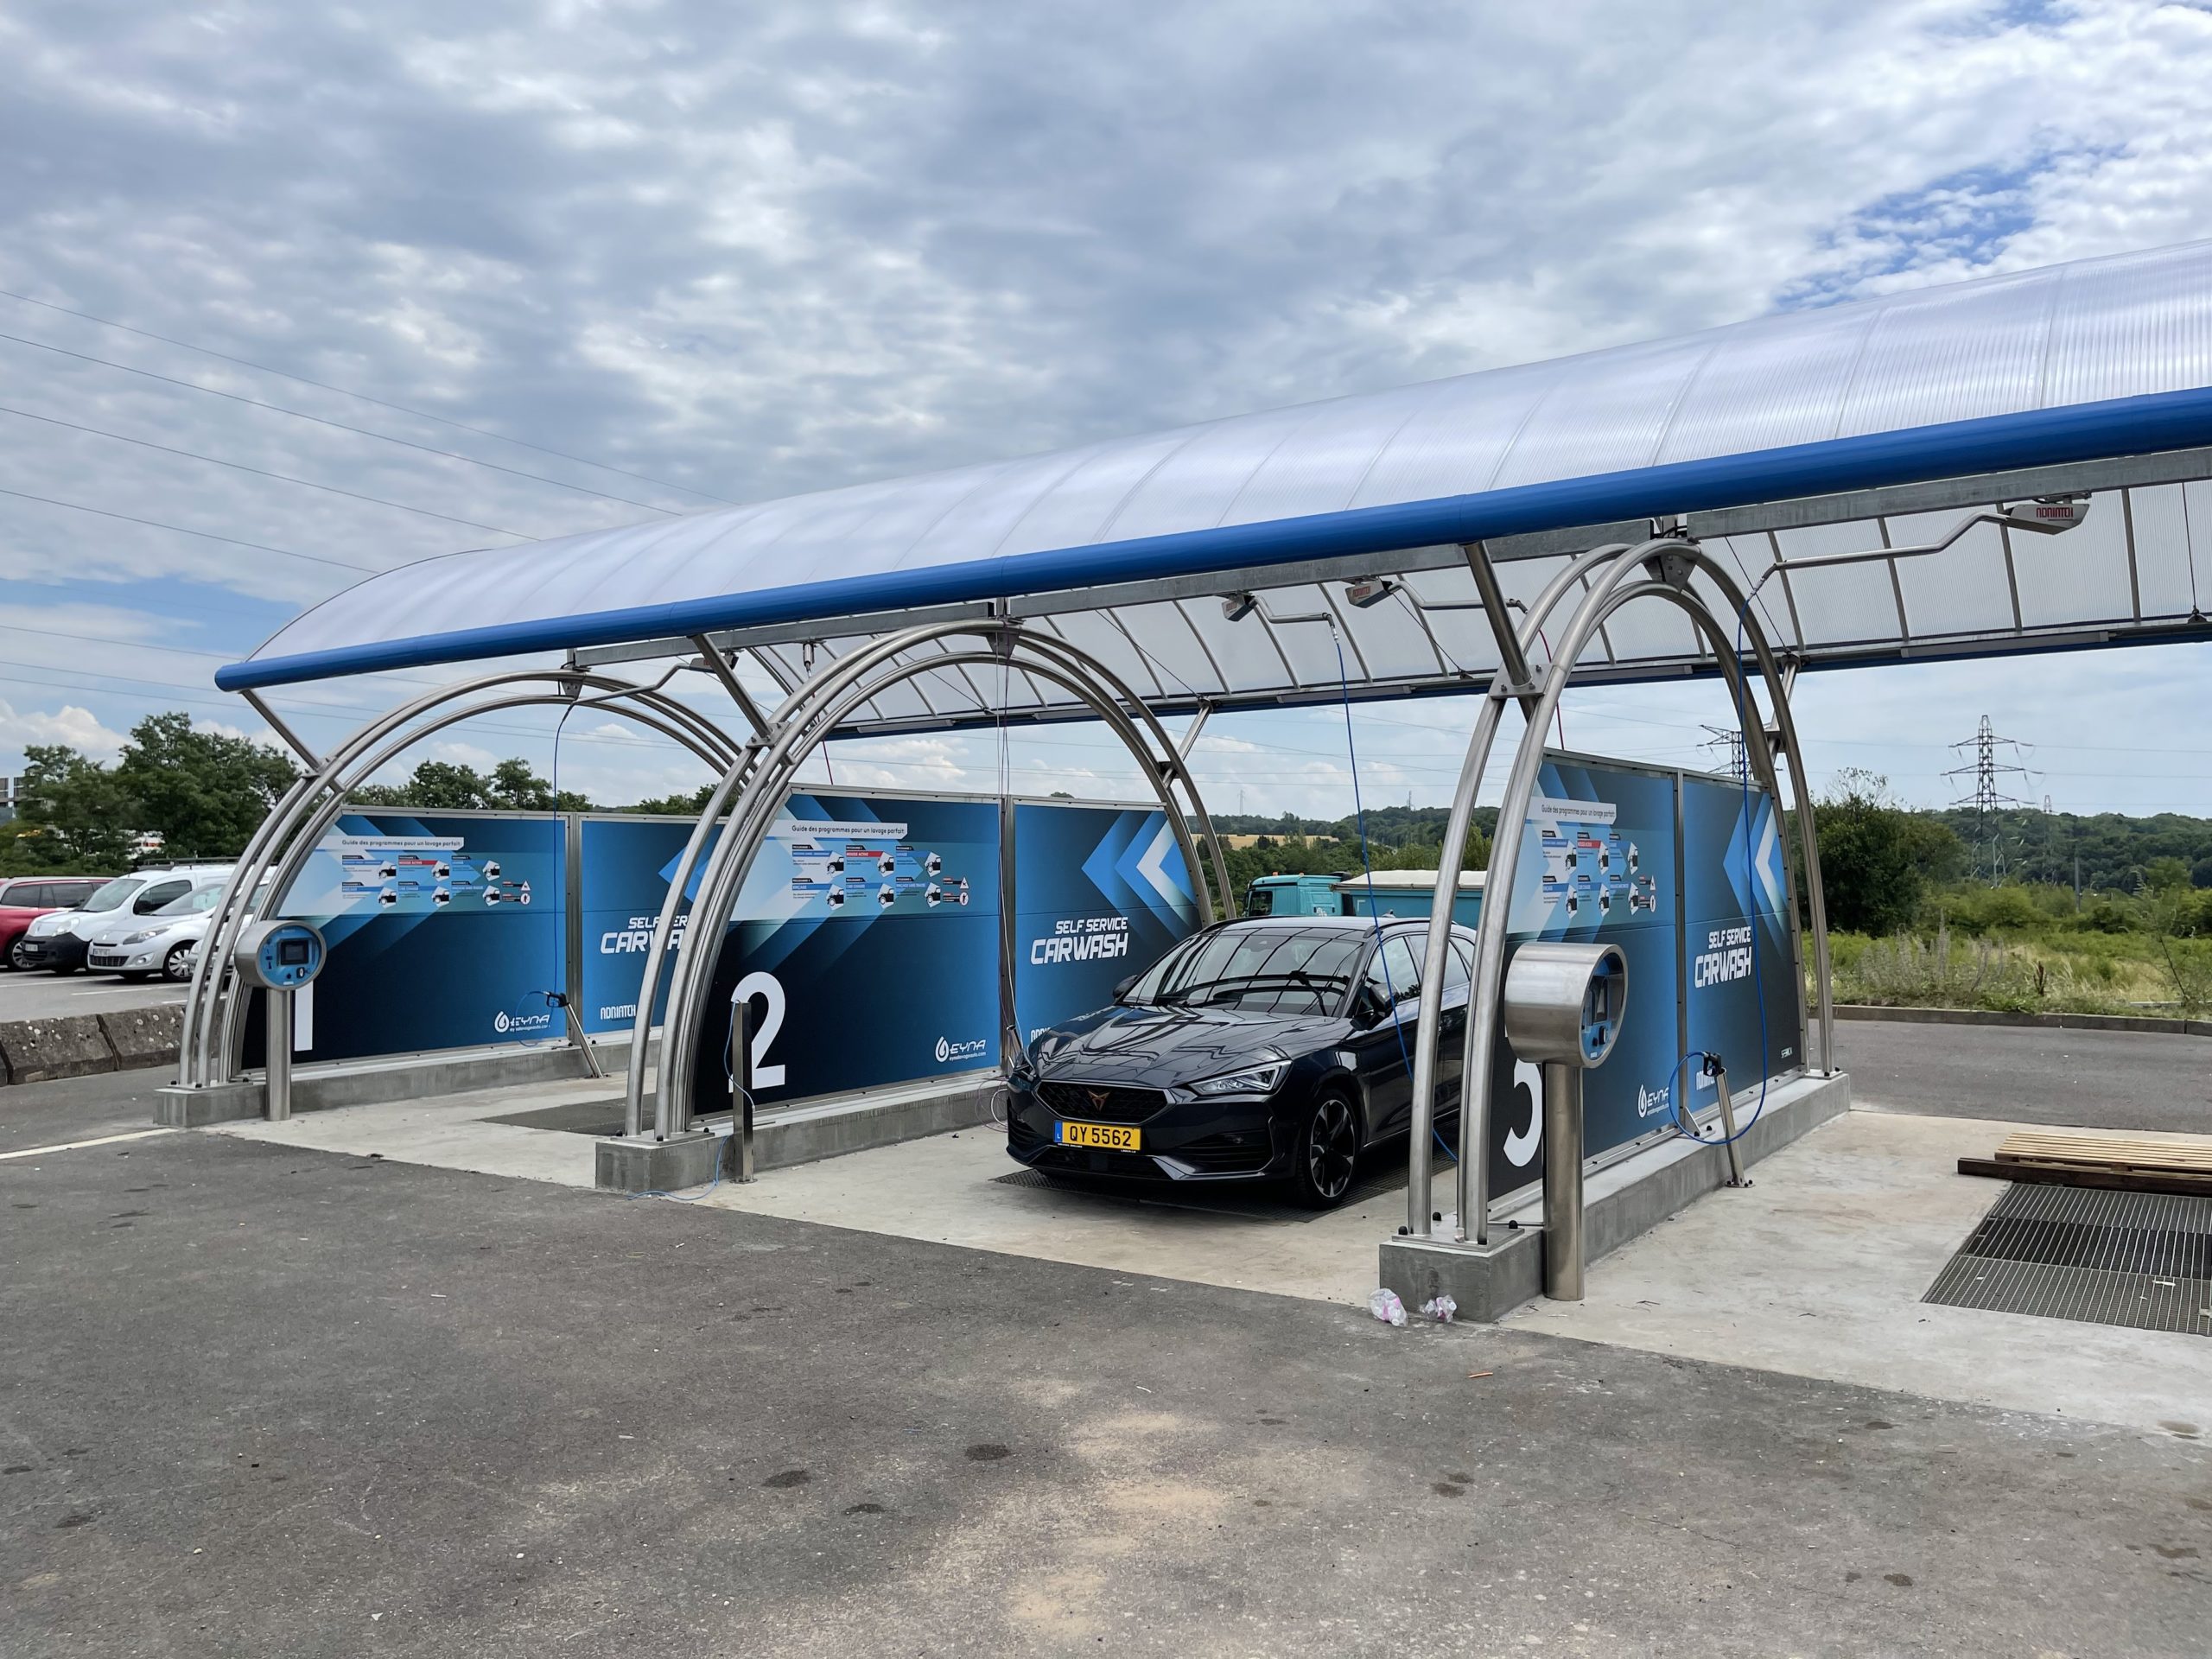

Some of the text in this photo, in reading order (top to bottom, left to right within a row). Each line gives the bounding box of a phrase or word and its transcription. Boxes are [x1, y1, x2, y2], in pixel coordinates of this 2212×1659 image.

[628, 917, 660, 929] SELF
[1055, 917, 1128, 935] SELF SERVICE
[600, 929, 685, 954] CARA
[1030, 932, 1128, 965] CARWASH
[1708, 926, 1751, 949] SELF SERVICE
[1694, 946, 1752, 988] CARWASH
[728, 971, 786, 1093] 2
[950, 1039, 987, 1054] EYNA
[1070, 1126, 1088, 1142] QY
[1091, 1127, 1132, 1147] 5562
